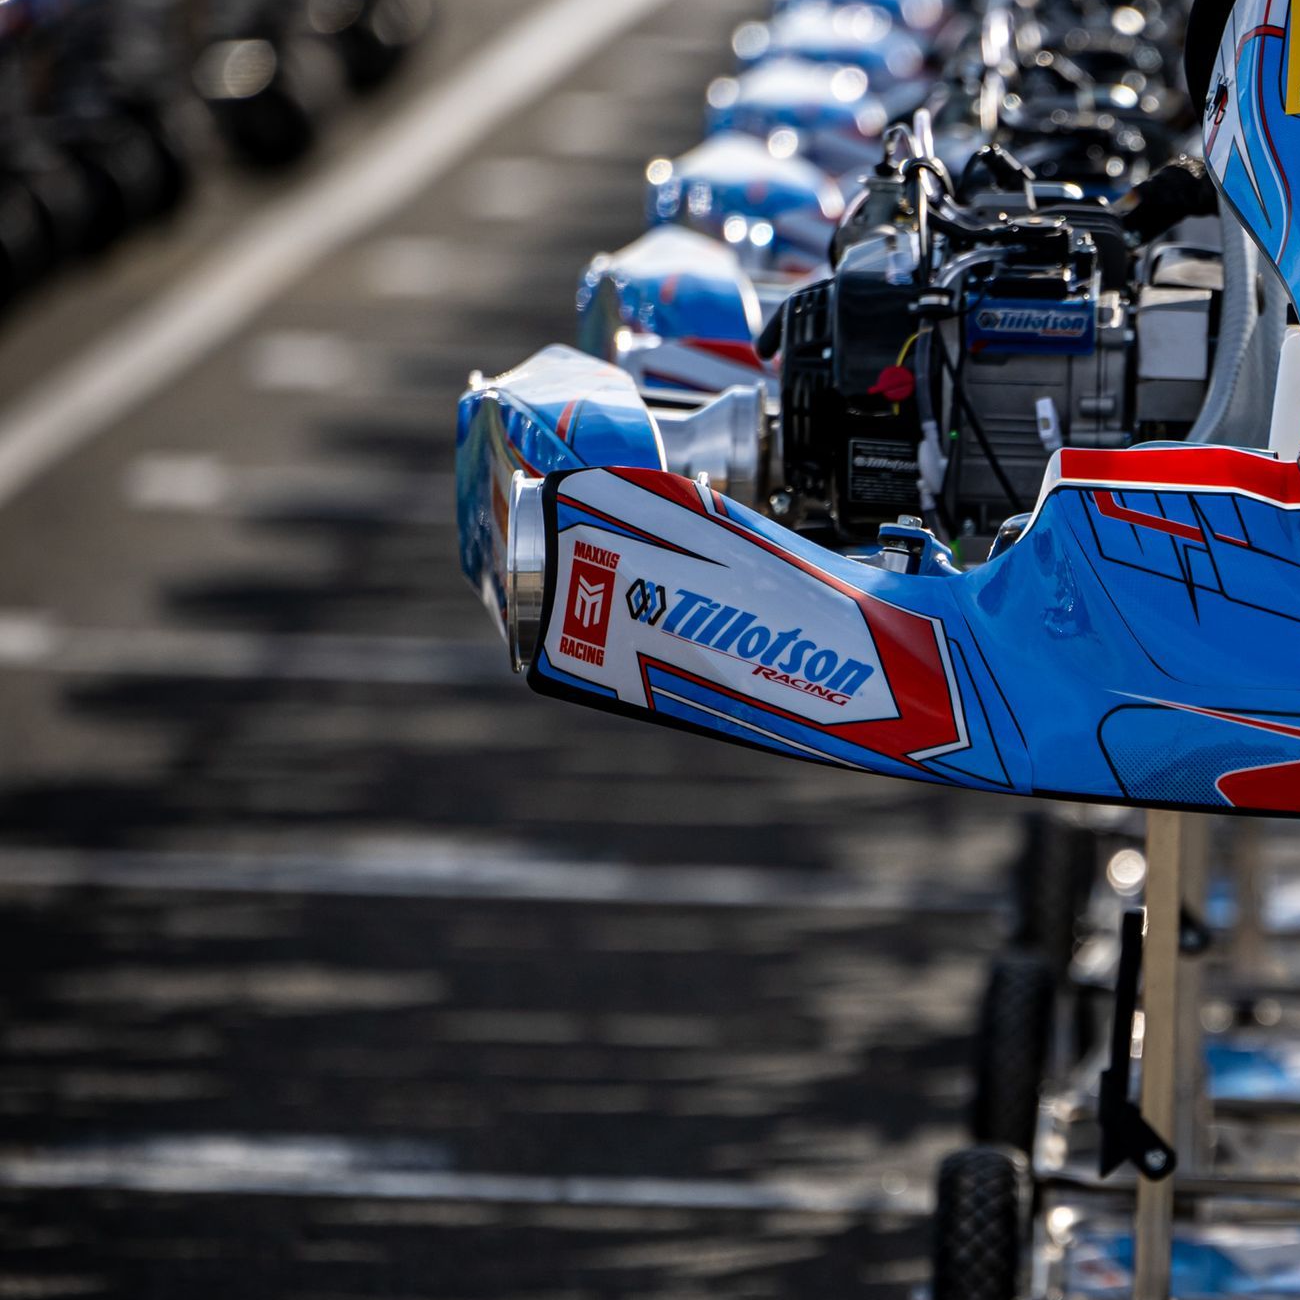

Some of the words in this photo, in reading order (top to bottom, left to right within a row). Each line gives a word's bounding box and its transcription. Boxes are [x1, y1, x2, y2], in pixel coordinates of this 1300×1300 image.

[574, 540, 620, 570] MAXXIS
[559, 636, 605, 667] RACING
[661, 588, 874, 695] Tillotson
[752, 664, 851, 706] RACING
